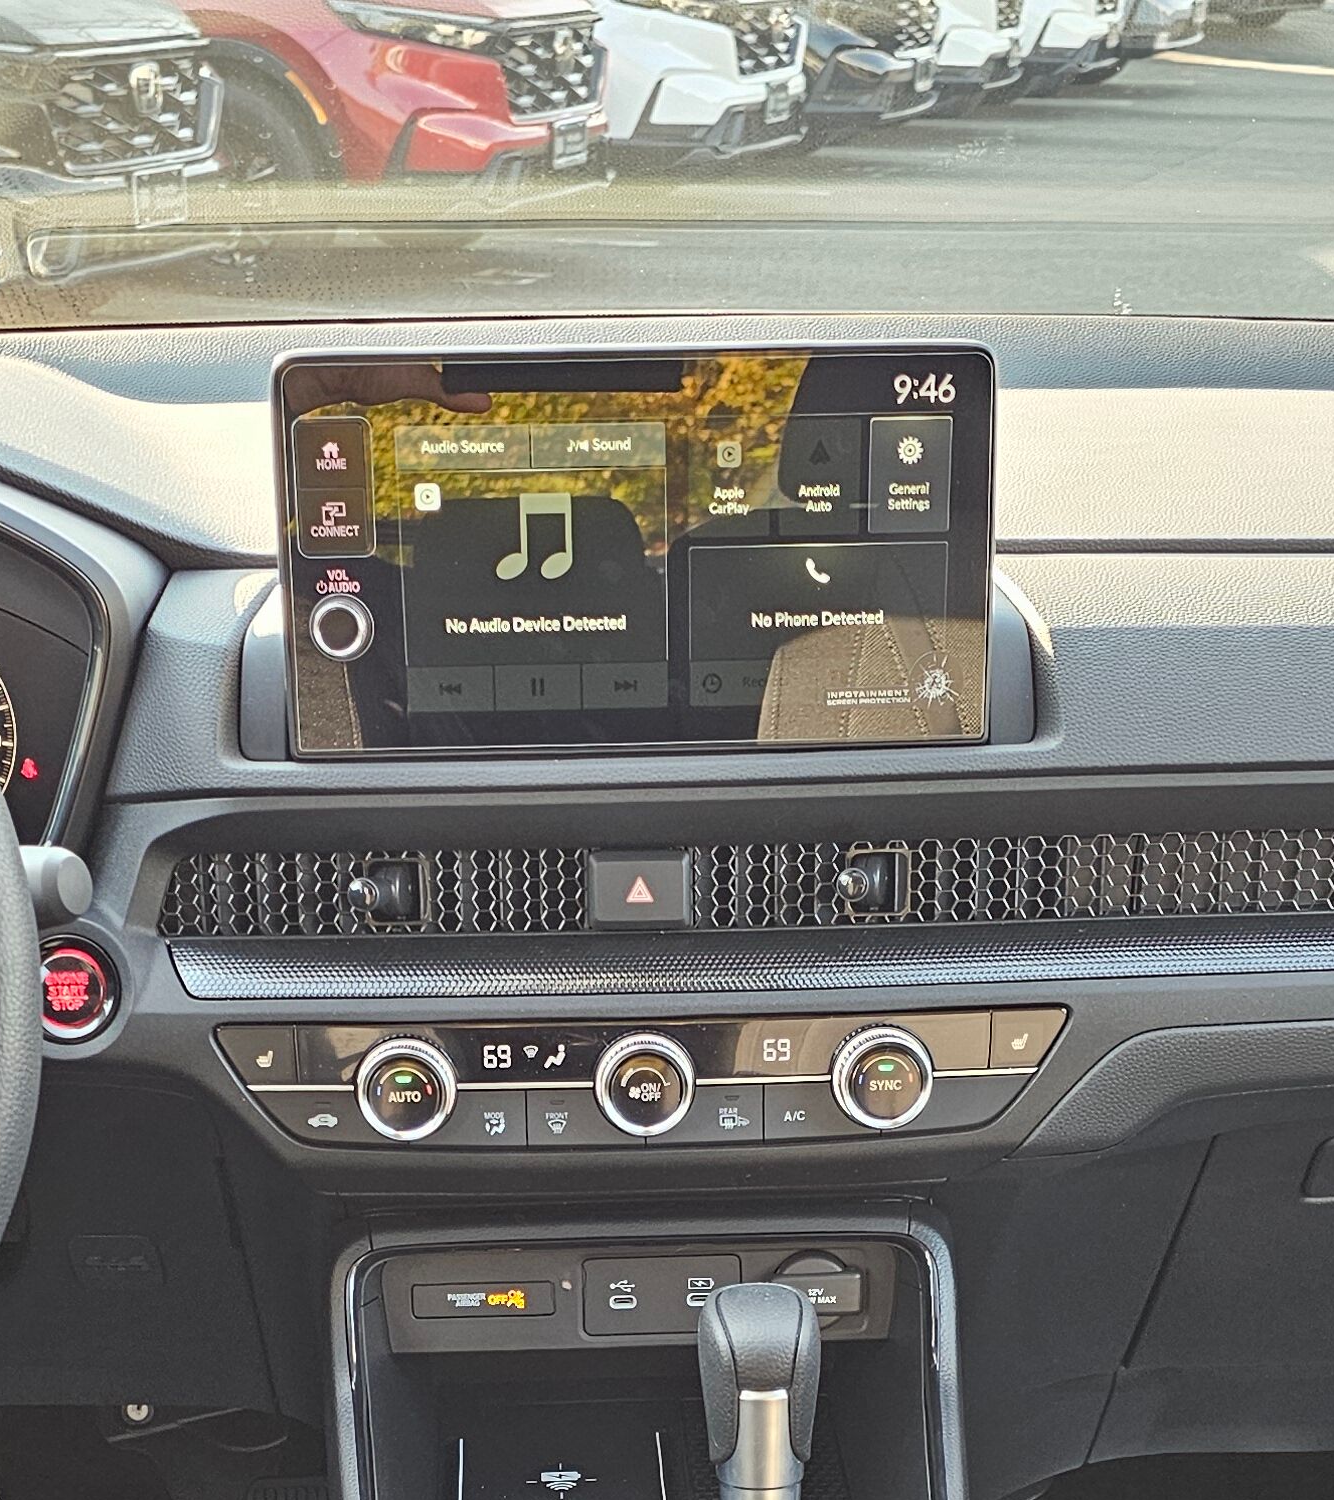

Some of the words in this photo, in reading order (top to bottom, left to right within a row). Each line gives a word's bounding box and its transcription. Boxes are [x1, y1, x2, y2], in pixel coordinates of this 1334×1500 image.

[894, 373, 956, 405] 9:46
[420, 440, 459, 455] Audio
[460, 440, 505, 454] Source
[592, 437, 632, 452] Sound
[316, 458, 347, 470] HOME
[713, 487, 745, 501] Apple
[798, 484, 840, 498] Android
[888, 482, 930, 495] General
[708, 502, 750, 516] CarPlay
[805, 500, 833, 512] Auto
[887, 497, 931, 512] Settings
[310, 525, 360, 538] CONNECT
[327, 569, 349, 582] VOL
[328, 581, 360, 594] AUDIO
[445, 618, 468, 635] No
[469, 617, 511, 634] Audio
[512, 616, 560, 633] Device
[562, 615, 627, 631] Detected
[751, 612, 772, 628] No
[775, 611, 819, 628] Phone
[821, 610, 884, 627] Detected
[827, 689, 910, 699] INFOTAINMENT
[45, 971, 90, 986] ENGINE
[48, 985, 87, 996] START
[51, 1000, 85, 1012] STOP
[762, 1038, 791, 1061] 69
[482, 1044, 512, 1069] 69
[641, 1082, 661, 1093] ON/
[869, 1079, 902, 1091] SYNC
[388, 1090, 421, 1103] AUTO
[641, 1091, 661, 1102] OFF
[483, 1111, 505, 1119] MODE
[545, 1112, 569, 1120] FRONT
[719, 1107, 739, 1115] REAR
[783, 1110, 806, 1122] A/C
[808, 1288, 824, 1296] 12V
[487, 1294, 508, 1305] OFF
[817, 1296, 837, 1304] MAX
